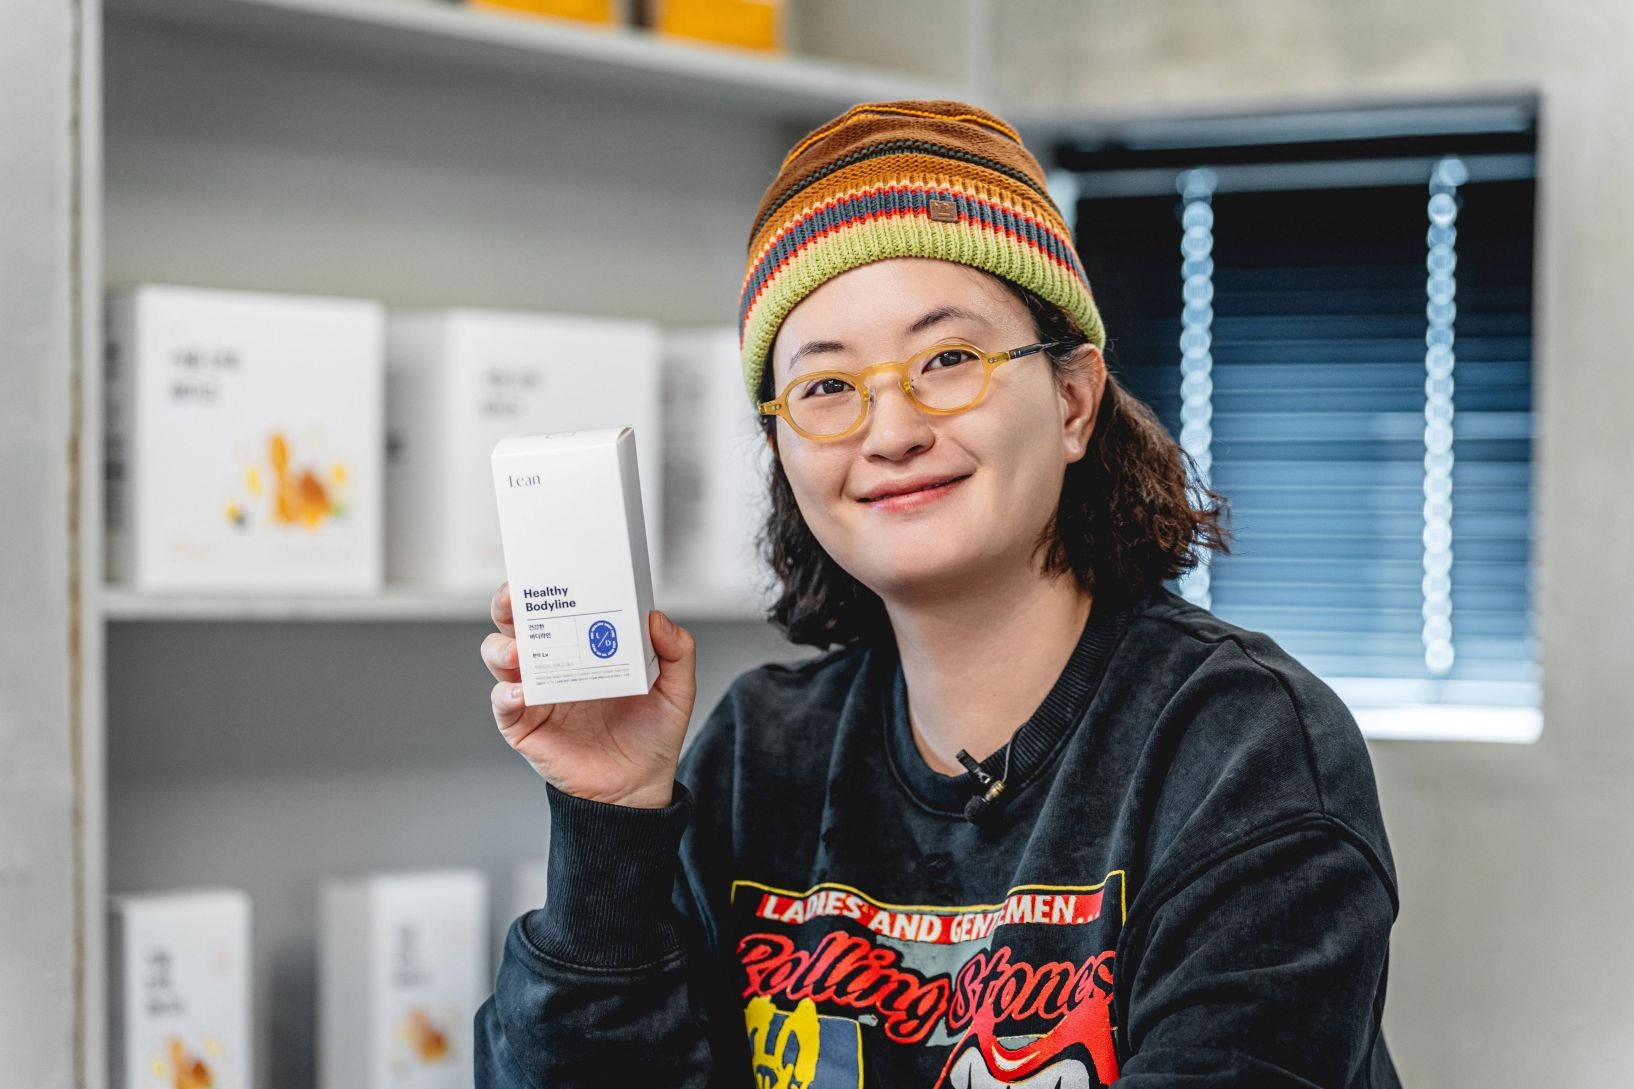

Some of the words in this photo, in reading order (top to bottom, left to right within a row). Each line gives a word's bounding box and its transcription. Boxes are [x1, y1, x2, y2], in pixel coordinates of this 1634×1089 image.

[508, 474, 541, 488] Lean
[523, 586, 569, 599] Healthy
[525, 599, 577, 612] Bodyline
[529, 632, 552, 640] 바디라인
[763, 890, 863, 925] LADIES
[867, 910, 942, 944] AND
[736, 930, 950, 1044] Rolling
[949, 945, 1117, 1030] Stones
